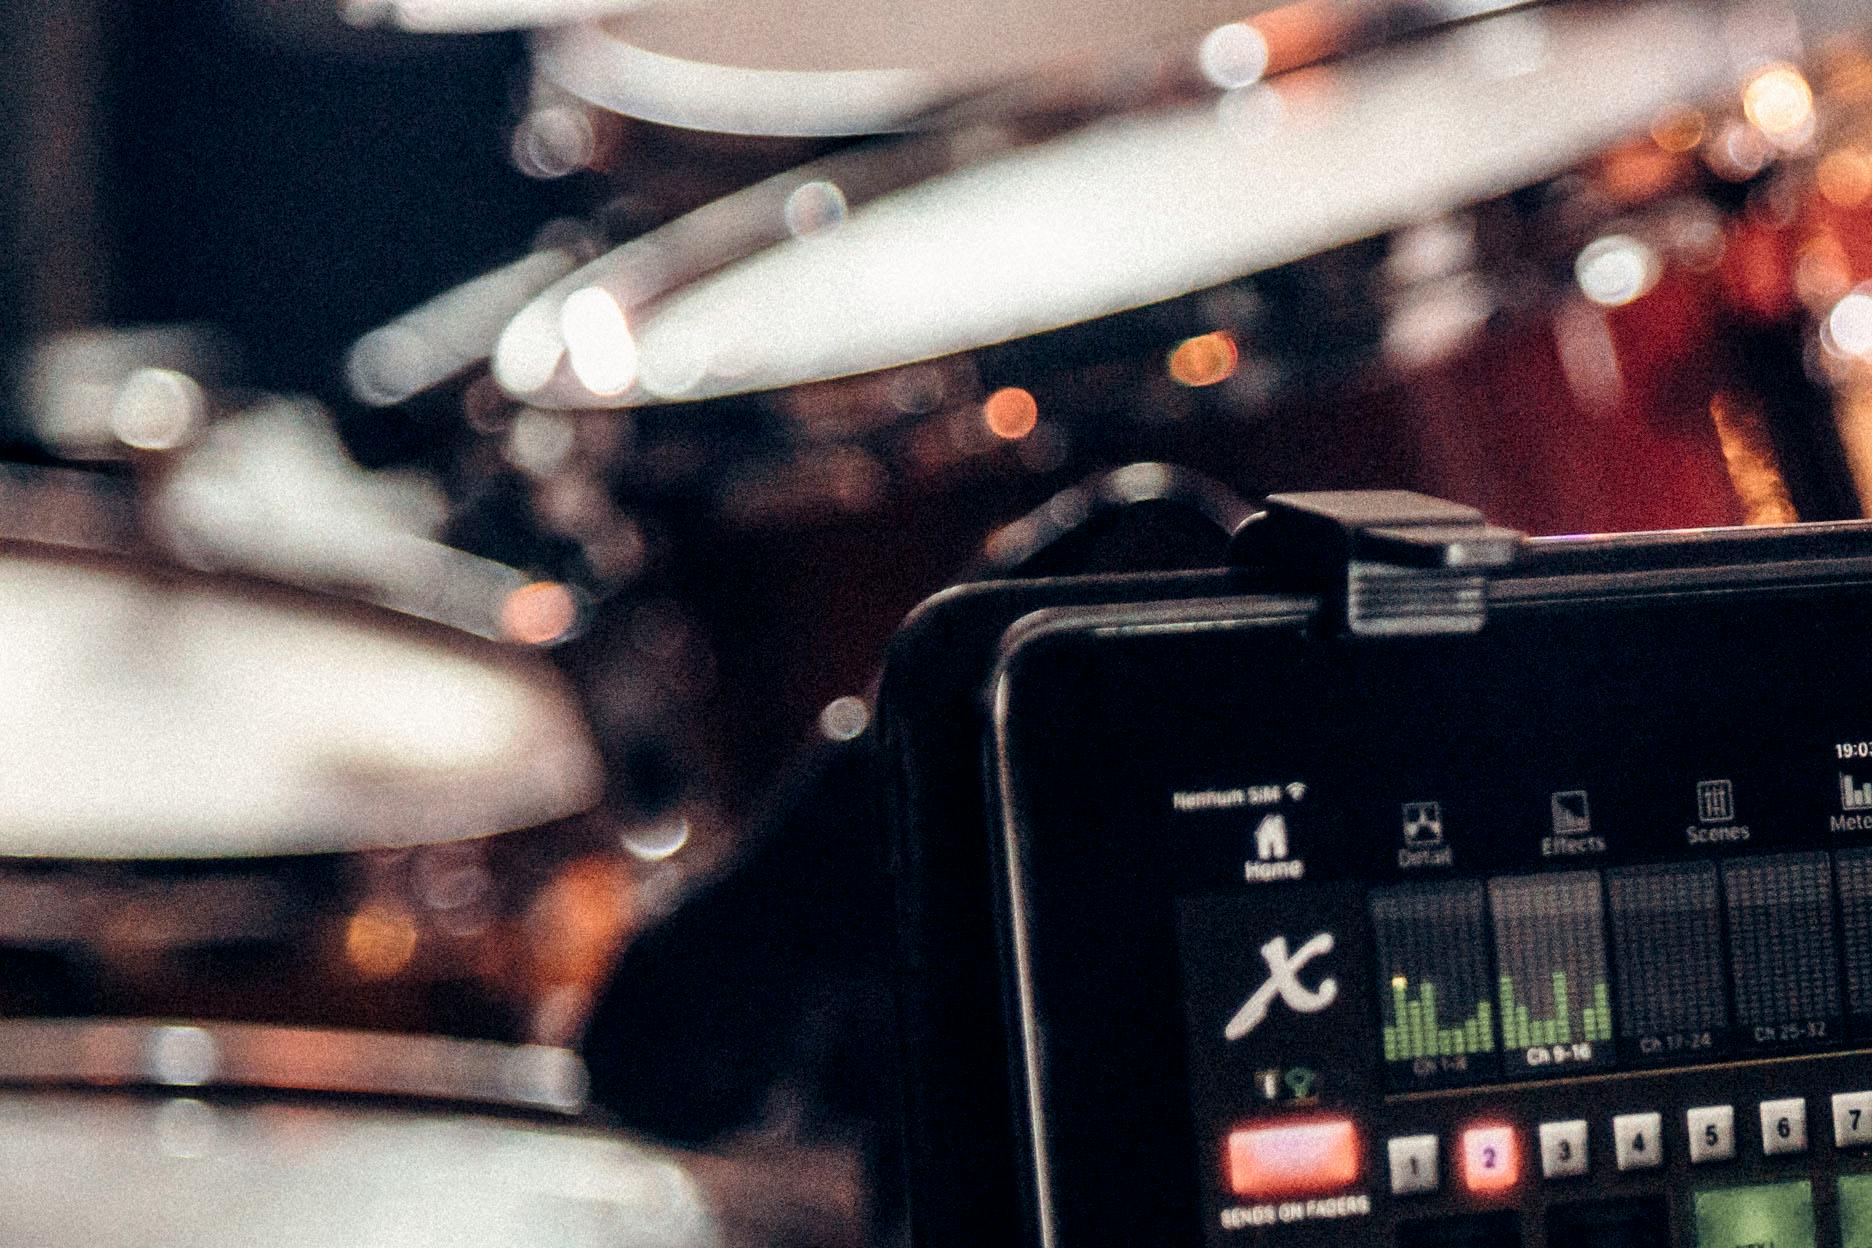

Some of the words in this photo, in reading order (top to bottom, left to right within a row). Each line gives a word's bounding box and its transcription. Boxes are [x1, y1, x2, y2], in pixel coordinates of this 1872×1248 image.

[1686, 825, 1750, 845] Scenes
[1542, 836, 1605, 856] Effects
[1245, 859, 1304, 881] Home
[1777, 1117, 1790, 1138] 6
[1849, 1110, 1862, 1130] 7
[1632, 1131, 1645, 1151] 4
[1705, 1125, 1718, 1146] 5
[1483, 1147, 1496, 1169] 2
[1558, 1140, 1571, 1161] 3
[1221, 1204, 1276, 1230] SENDS
[1279, 1201, 1302, 1223] ON
[1306, 1195, 1371, 1219] FADERS
